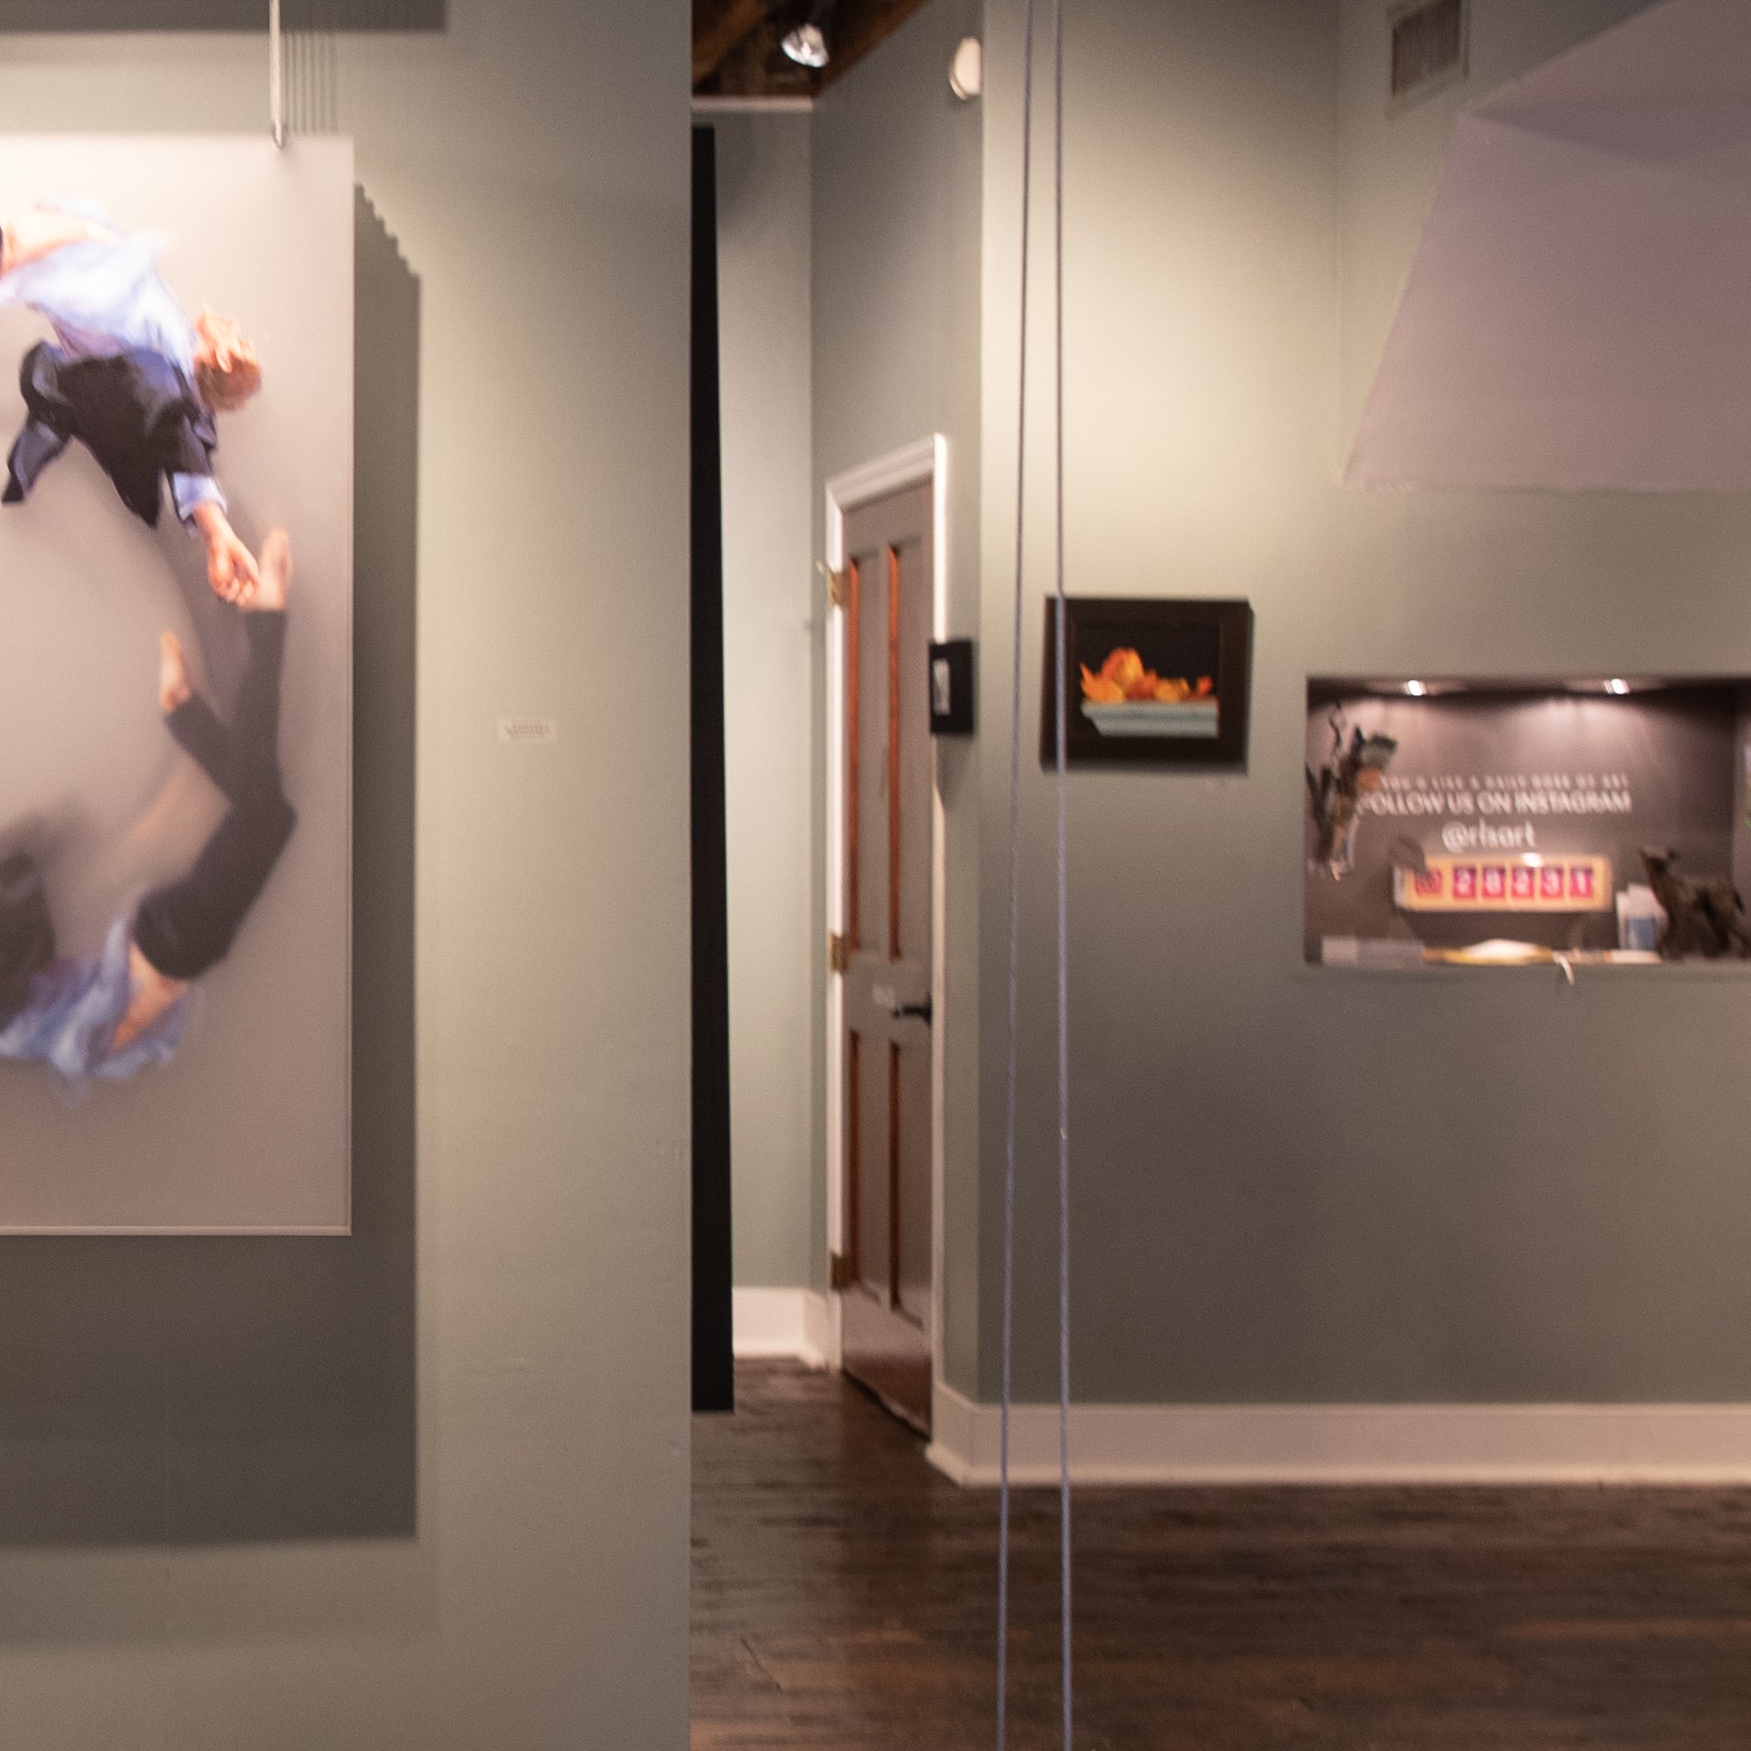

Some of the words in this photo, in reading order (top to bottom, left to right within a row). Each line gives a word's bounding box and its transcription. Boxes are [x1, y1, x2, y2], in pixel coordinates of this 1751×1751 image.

[1448, 790, 1474, 814] US
[1477, 790, 1512, 814] ON
[1515, 790, 1633, 814] INSTAGRAM
[1441, 816, 1536, 853] @rlsart
